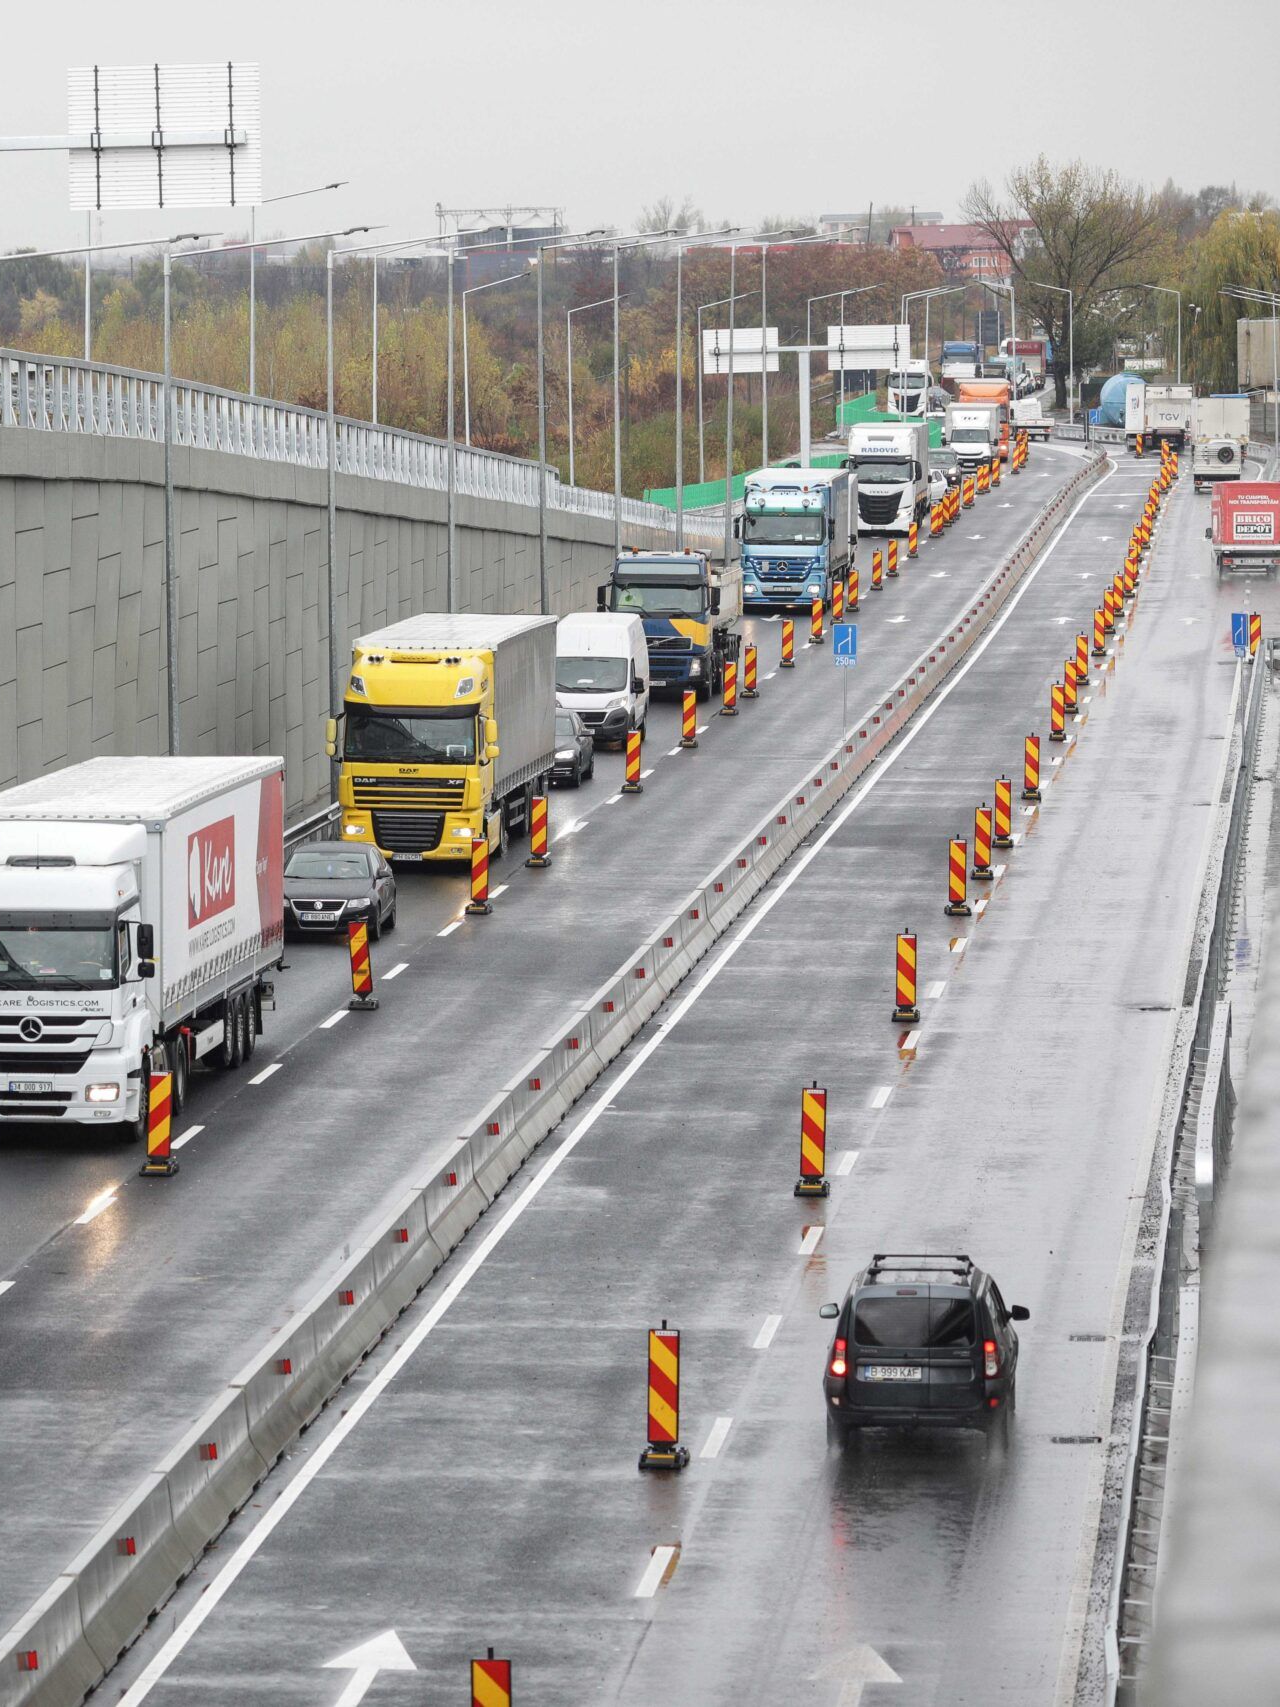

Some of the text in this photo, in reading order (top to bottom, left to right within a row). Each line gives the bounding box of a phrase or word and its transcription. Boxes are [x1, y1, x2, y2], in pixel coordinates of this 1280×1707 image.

[1159, 413, 1180, 421] TGV
[1236, 515, 1271, 523] BRICO
[835, 656, 849, 666] 250
[204, 839, 232, 909] Kare
[870, 1367, 878, 1377] B
[881, 1367, 898, 1377] 999
